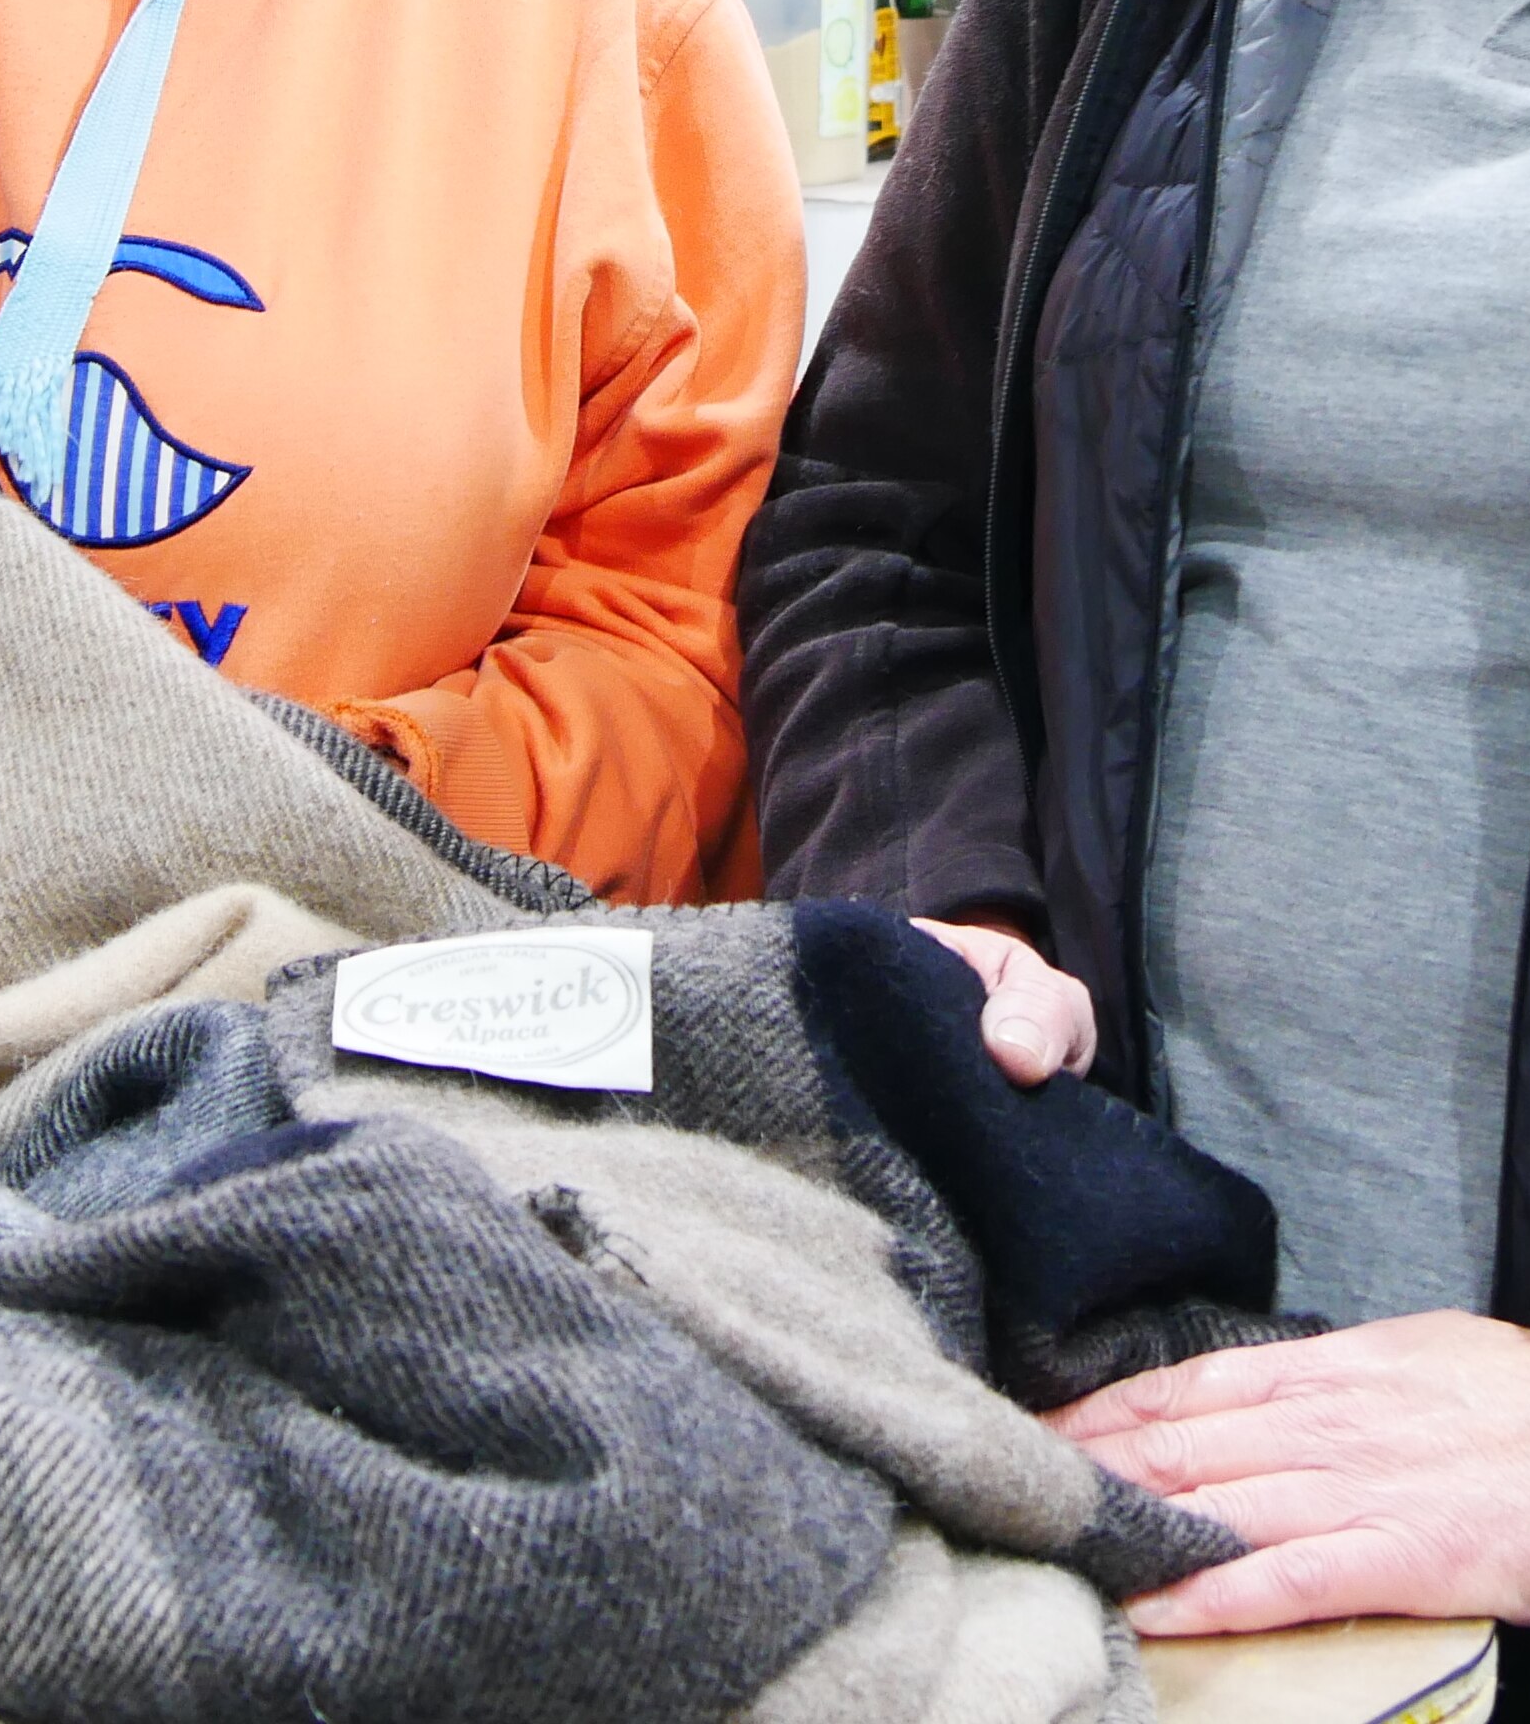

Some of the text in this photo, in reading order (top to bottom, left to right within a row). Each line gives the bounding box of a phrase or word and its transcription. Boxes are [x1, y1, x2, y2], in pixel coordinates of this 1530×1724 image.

[406, 948, 491, 977] AUSTRALIAN
[496, 948, 548, 961] ALPACA
[359, 963, 610, 1026] Creswick
[445, 1021, 551, 1046] Alpaca
